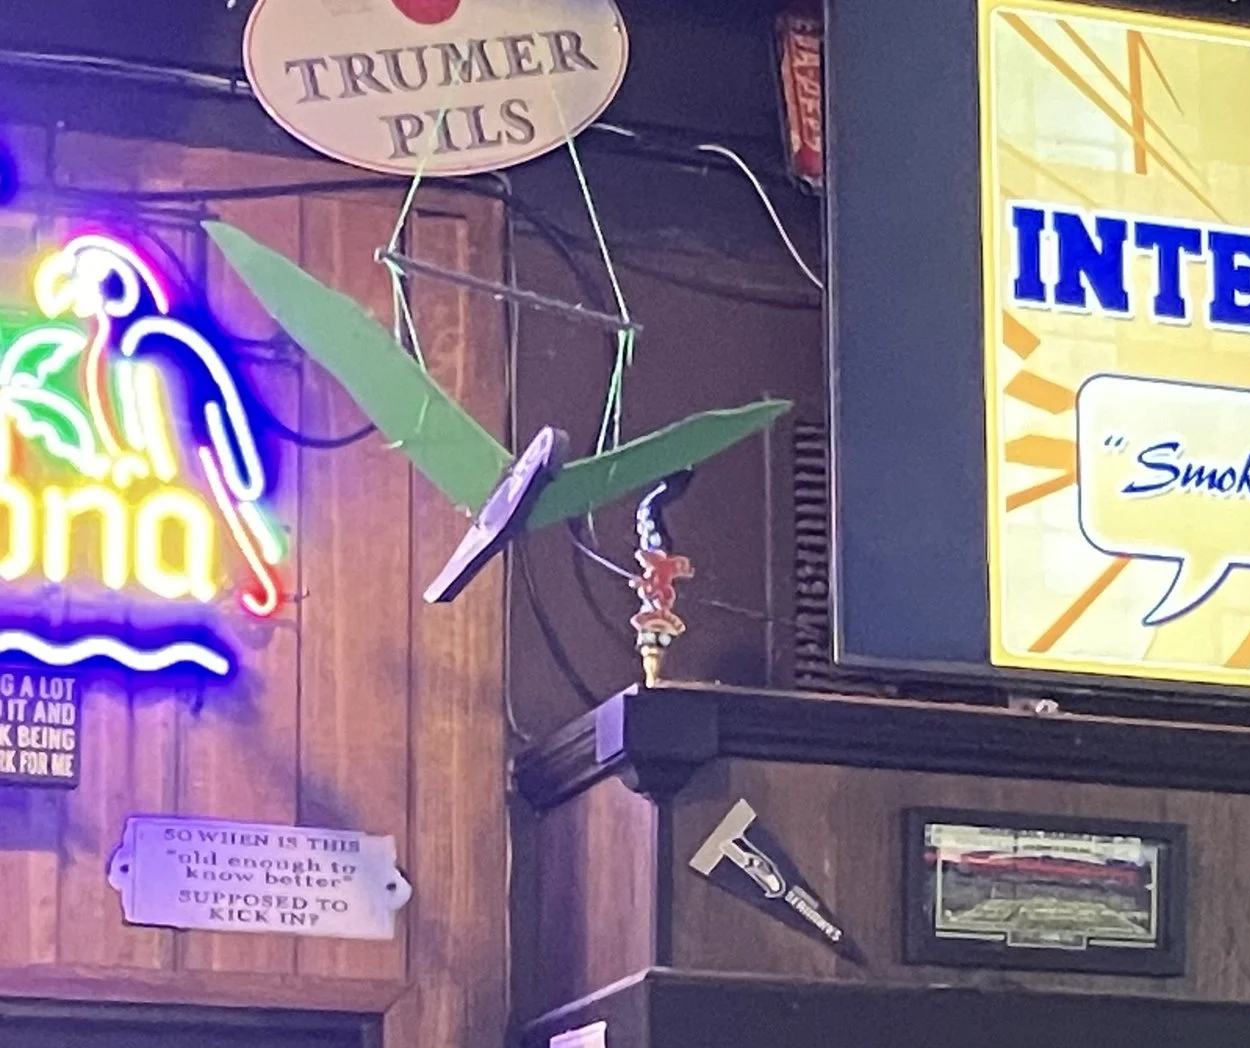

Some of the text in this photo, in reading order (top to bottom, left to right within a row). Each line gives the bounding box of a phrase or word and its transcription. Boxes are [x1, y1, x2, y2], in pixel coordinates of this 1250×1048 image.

[284, 29, 599, 105] TRUMER
[378, 98, 536, 160] PILS
[20, 675, 34, 698] A
[39, 676, 77, 701] LOT
[7, 698, 76, 726] IT AND
[17, 725, 76, 751] BEING
[20, 751, 48, 775] FOR
[51, 753, 75, 778] ME
[164, 829, 361, 853] SO WHEN IS THIS
[186, 866, 254, 883] know
[228, 856, 321, 873] enough
[331, 861, 357, 875] to
[178, 889, 349, 913] SUPPOSED TO
[209, 907, 320, 927] KICK IN?
